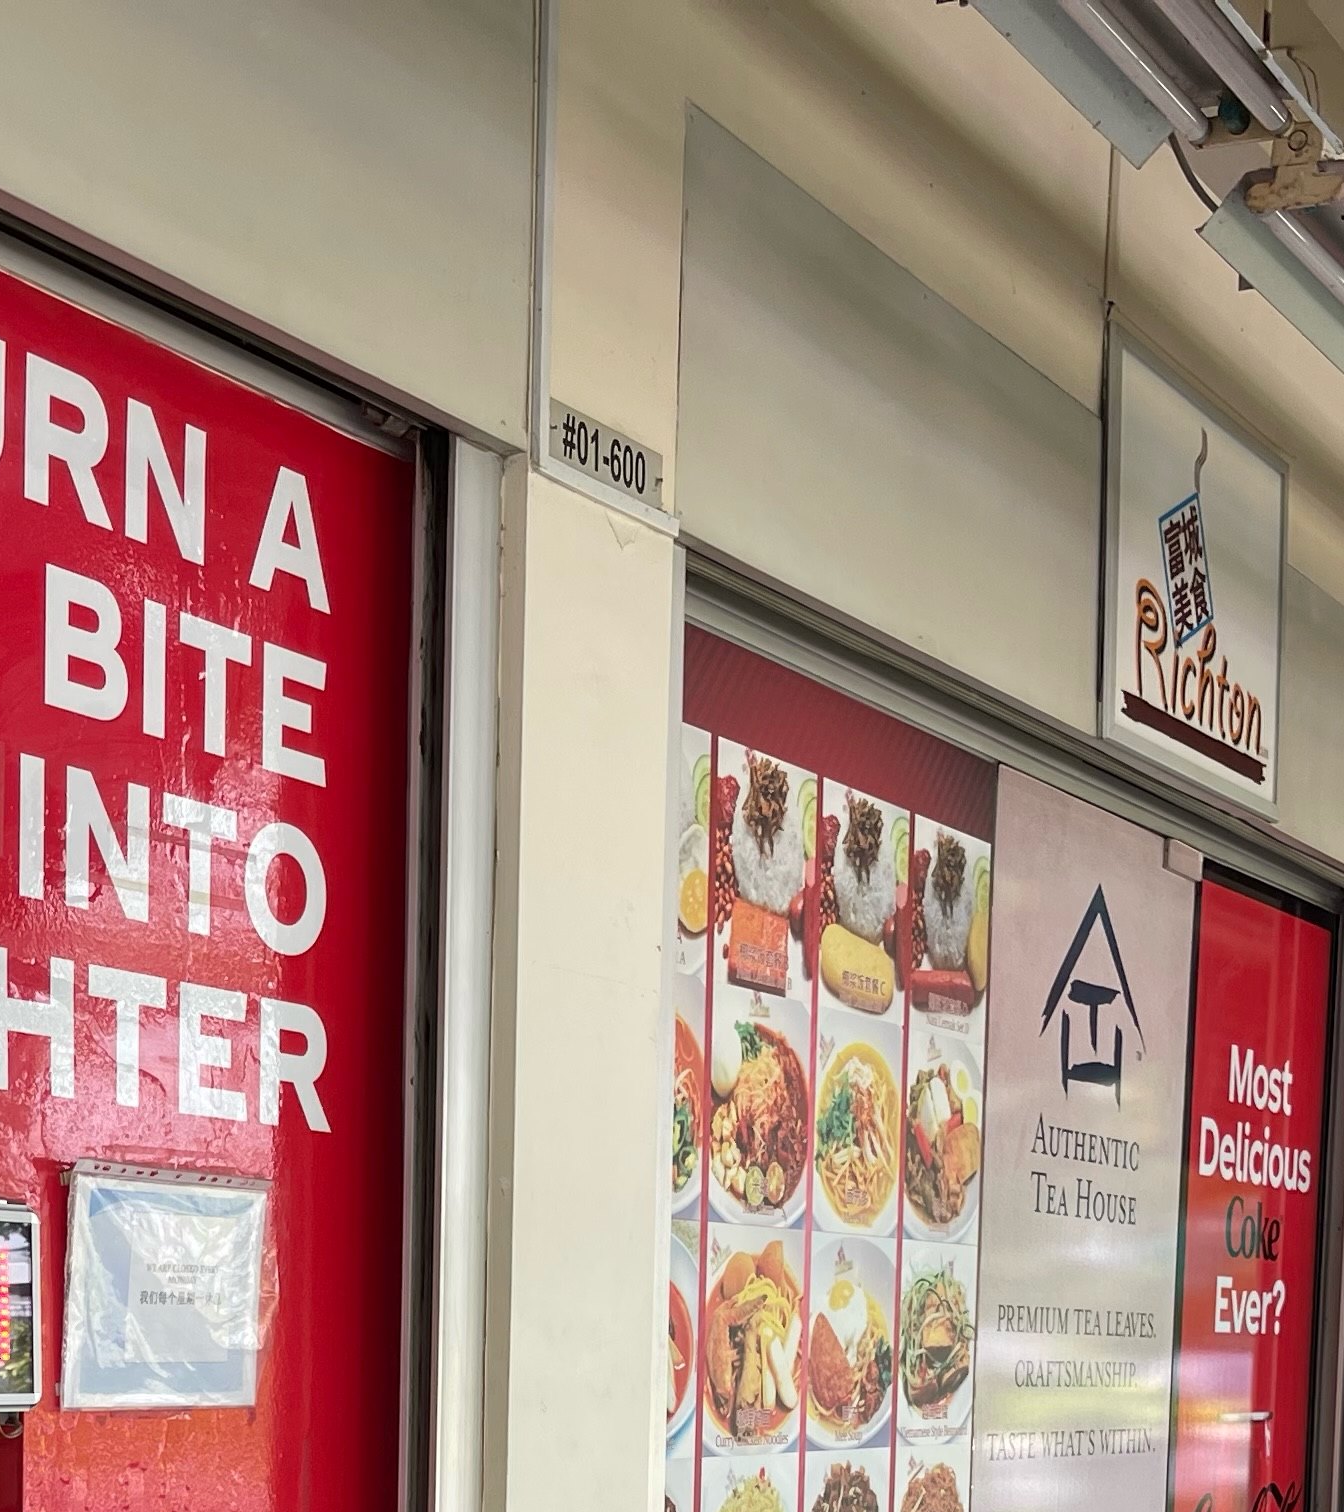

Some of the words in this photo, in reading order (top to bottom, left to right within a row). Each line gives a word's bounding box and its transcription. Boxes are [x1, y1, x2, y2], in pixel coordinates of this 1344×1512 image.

[562, 413, 646, 495] #01-600
[249, 465, 331, 614] A
[1163, 505, 1203, 581] 富城
[1171, 567, 1209, 638] 美食
[44, 562, 328, 787] BITE
[1134, 578, 1262, 756] Richton
[17, 752, 329, 957] INTO
[1228, 1043, 1293, 1116] Most
[1030, 1112, 1140, 1172] AUTHENTIC
[1198, 1116, 1311, 1194] Delicious
[1030, 1171, 1069, 1217] TEA
[1075, 1178, 1137, 1226] HOUSE
[1225, 1195, 1281, 1262] Coke
[997, 1304, 1070, 1335] PREMIUM
[1074, 1308, 1102, 1336] TEA
[1106, 1310, 1157, 1339] LEAVES.
[1214, 1275, 1286, 1335] Ever?
[1014, 1359, 1138, 1389] CRAFTSMANSHIP.
[987, 1431, 1036, 1461] TASTE
[1041, 1429, 1096, 1458] WHAT'S
[1100, 1427, 1156, 1455] WITHIN.
